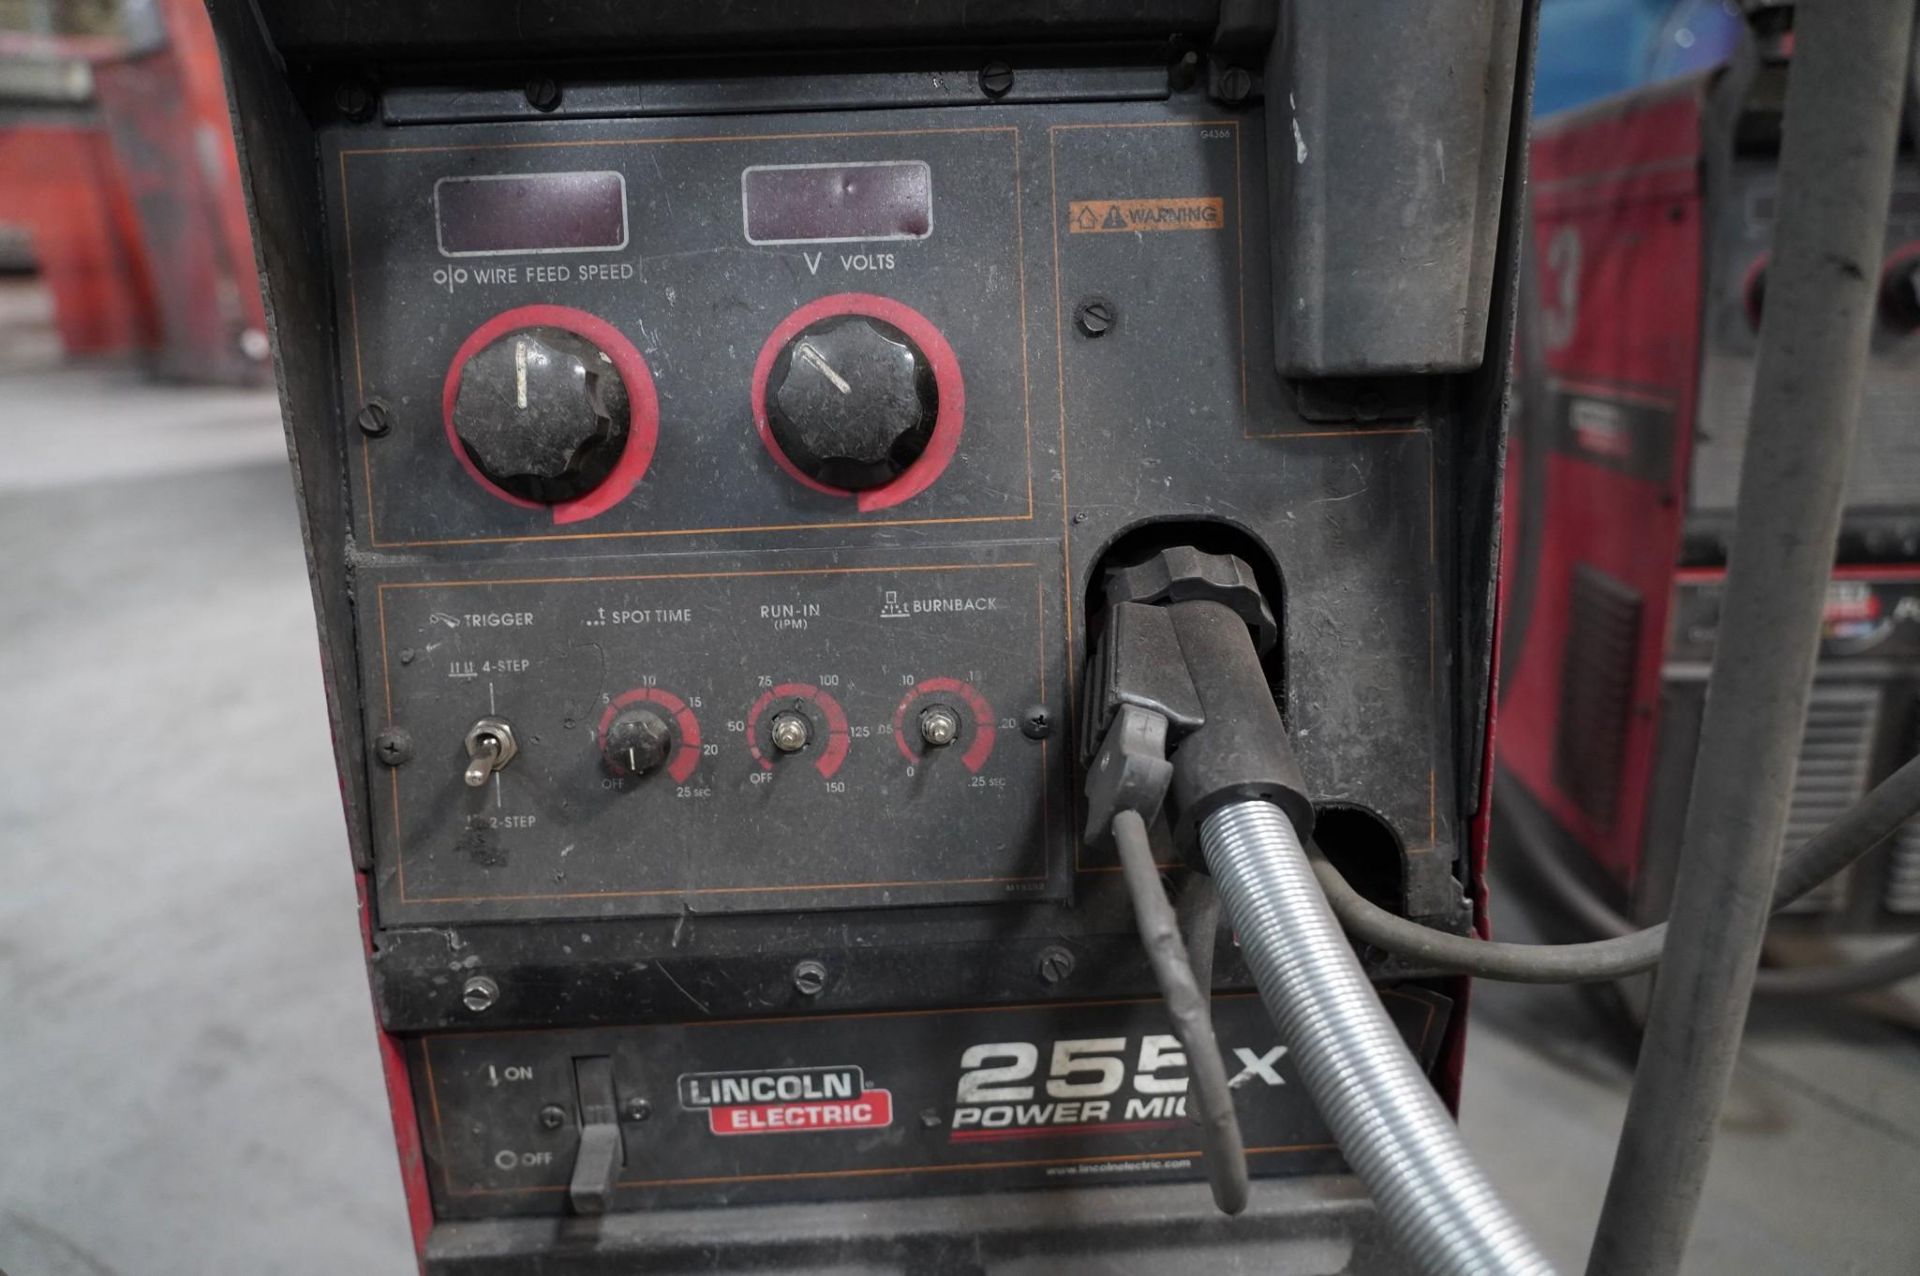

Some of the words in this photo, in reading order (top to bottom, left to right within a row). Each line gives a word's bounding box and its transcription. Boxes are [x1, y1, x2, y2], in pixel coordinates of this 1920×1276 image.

[1128, 207, 1217, 224] WARNING
[840, 253, 895, 272] VOLTS
[474, 265, 518, 285] WIRE
[526, 263, 571, 283] FEED
[579, 262, 634, 281] SPEED
[760, 604, 821, 618] RUN-IN
[913, 598, 997, 613] BURNBACK
[464, 612, 534, 627] TRIGGER
[612, 610, 651, 624] SPOT
[655, 608, 692, 623] TIME
[774, 618, 808, 631] (IPM)
[482, 660, 530, 674] 4-STEP
[642, 675, 656, 687] 10
[758, 676, 773, 687] 75
[819, 675, 839, 686] 100
[602, 693, 610, 704] 5
[689, 696, 702, 708] 15
[728, 721, 745, 733] 50
[850, 726, 870, 738] 125
[703, 744, 719, 756] 20
[750, 773, 773, 784] OFF
[907, 767, 914, 778] 0
[602, 778, 624, 790] OFF
[825, 782, 845, 793] 150
[676, 786, 692, 798] 25
[489, 816, 536, 829] 2-STEP
[505, 1066, 533, 1080] ON
[690, 1073, 852, 1104] LINCOLN
[732, 1104, 873, 1129] ELECTRIC
[952, 1101, 1110, 1129] POWER
[522, 1152, 553, 1166] OFF
[1046, 1159, 1191, 1175] www.lincolnelectric.com
